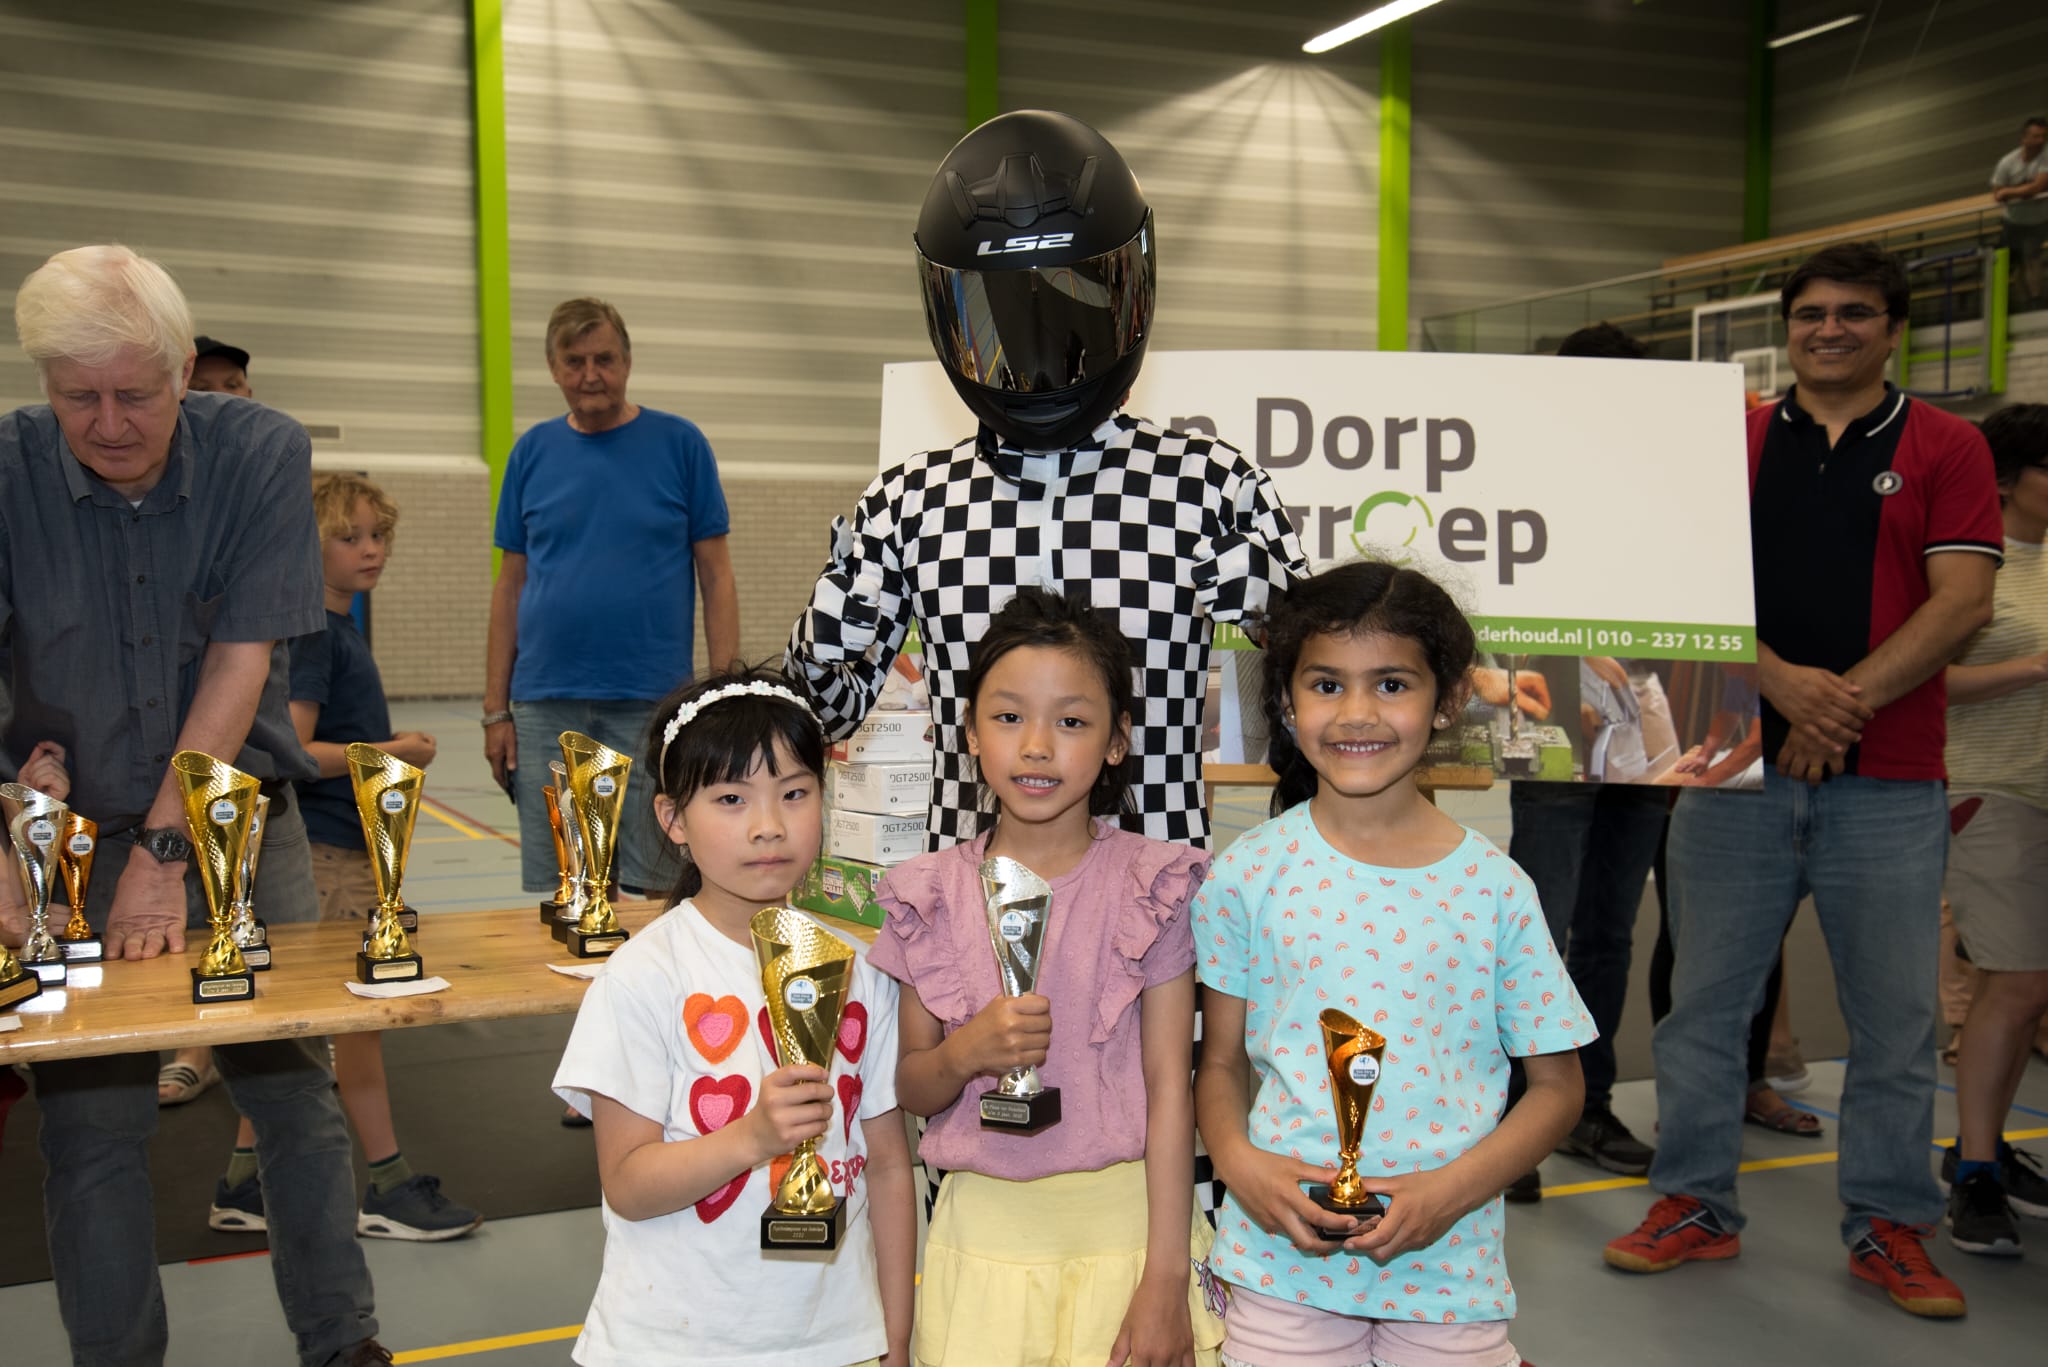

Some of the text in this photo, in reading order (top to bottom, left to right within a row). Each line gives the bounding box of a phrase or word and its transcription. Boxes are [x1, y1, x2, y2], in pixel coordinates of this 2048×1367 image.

[977, 232, 1074, 256] LS2
[1256, 397, 1476, 493] Dorp
[1285, 490, 1549, 585] roep
[1474, 626, 1583, 645] derhoud.nl
[1597, 631, 1633, 646] 010
[1652, 632, 1686, 649] 237
[1692, 634, 1715, 650] 12
[1719, 636, 1743, 651] 55
